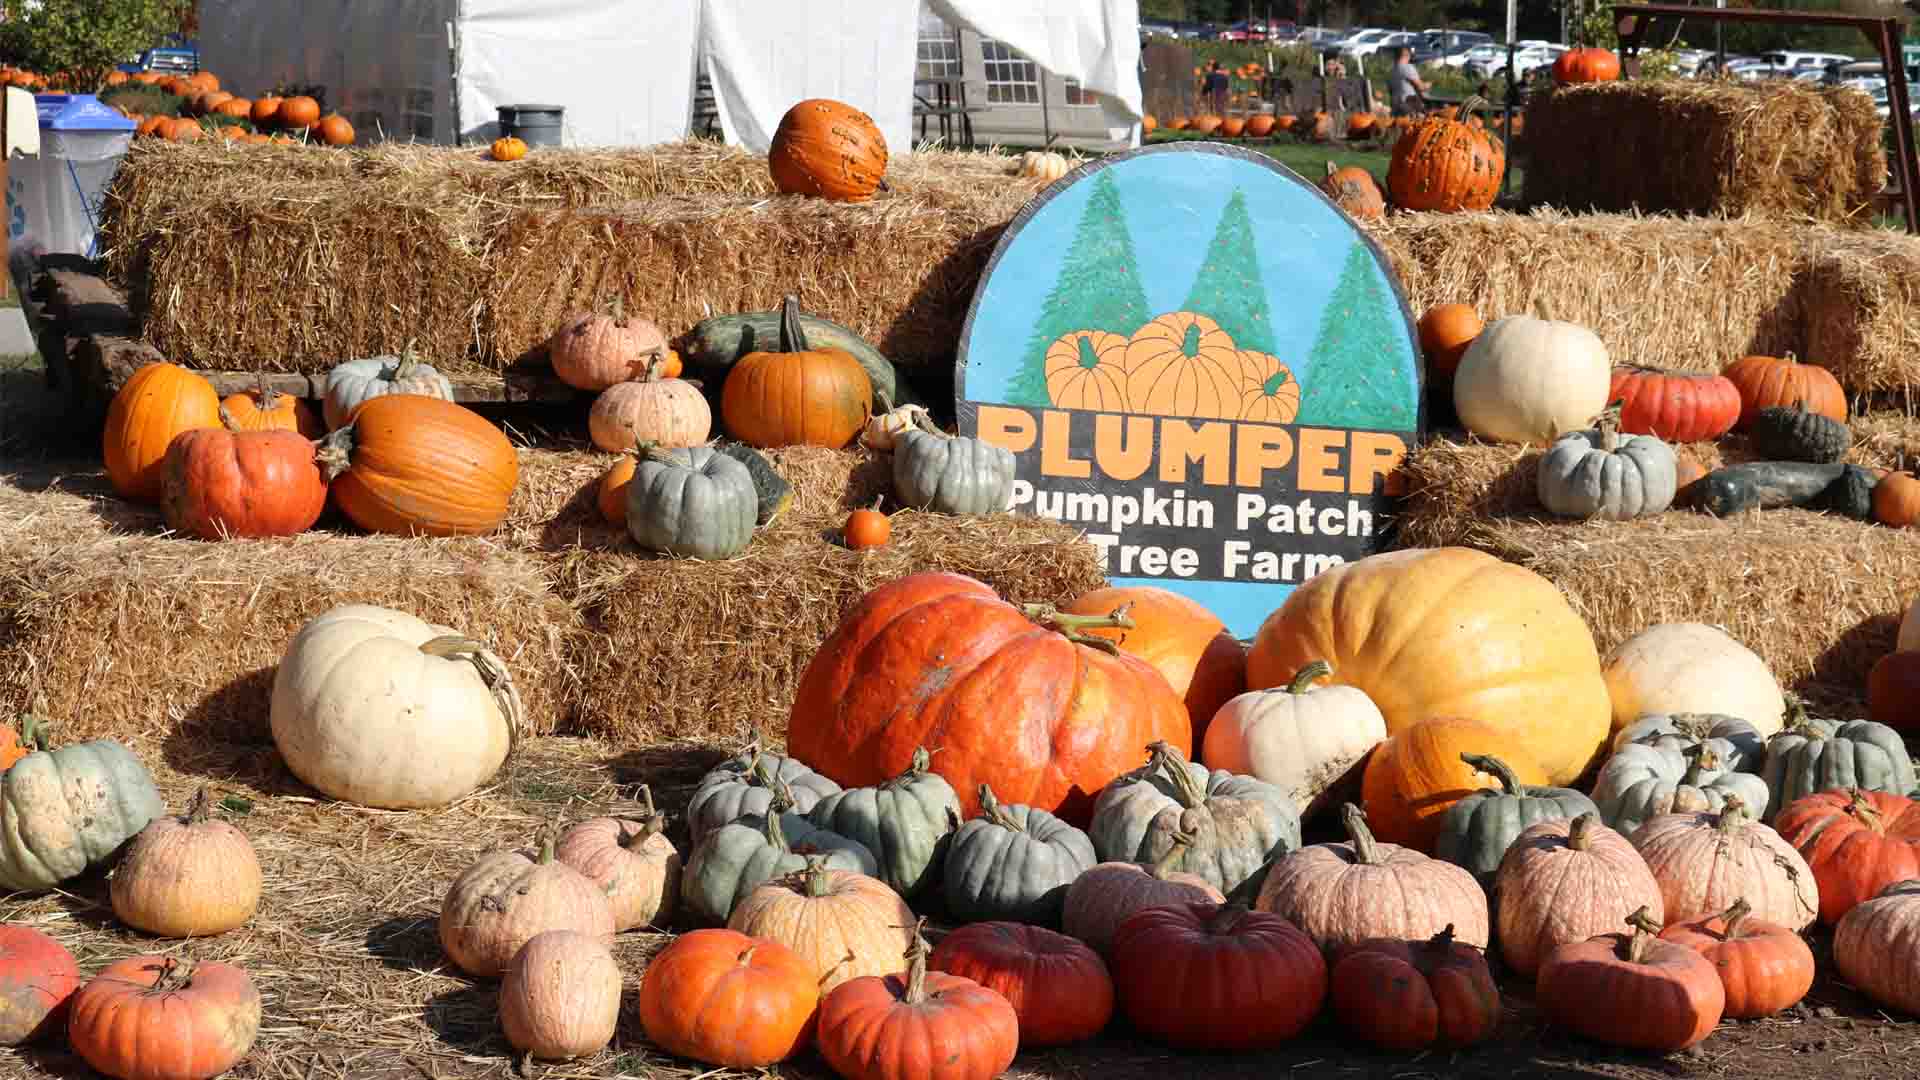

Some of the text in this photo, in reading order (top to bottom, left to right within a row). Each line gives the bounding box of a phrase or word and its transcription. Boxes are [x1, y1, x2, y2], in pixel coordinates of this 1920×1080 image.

[977, 405, 1408, 494] PLUMPER
[1006, 479, 1373, 537] Pumpkin Patch
[1087, 533, 1345, 580] Tree Farm
